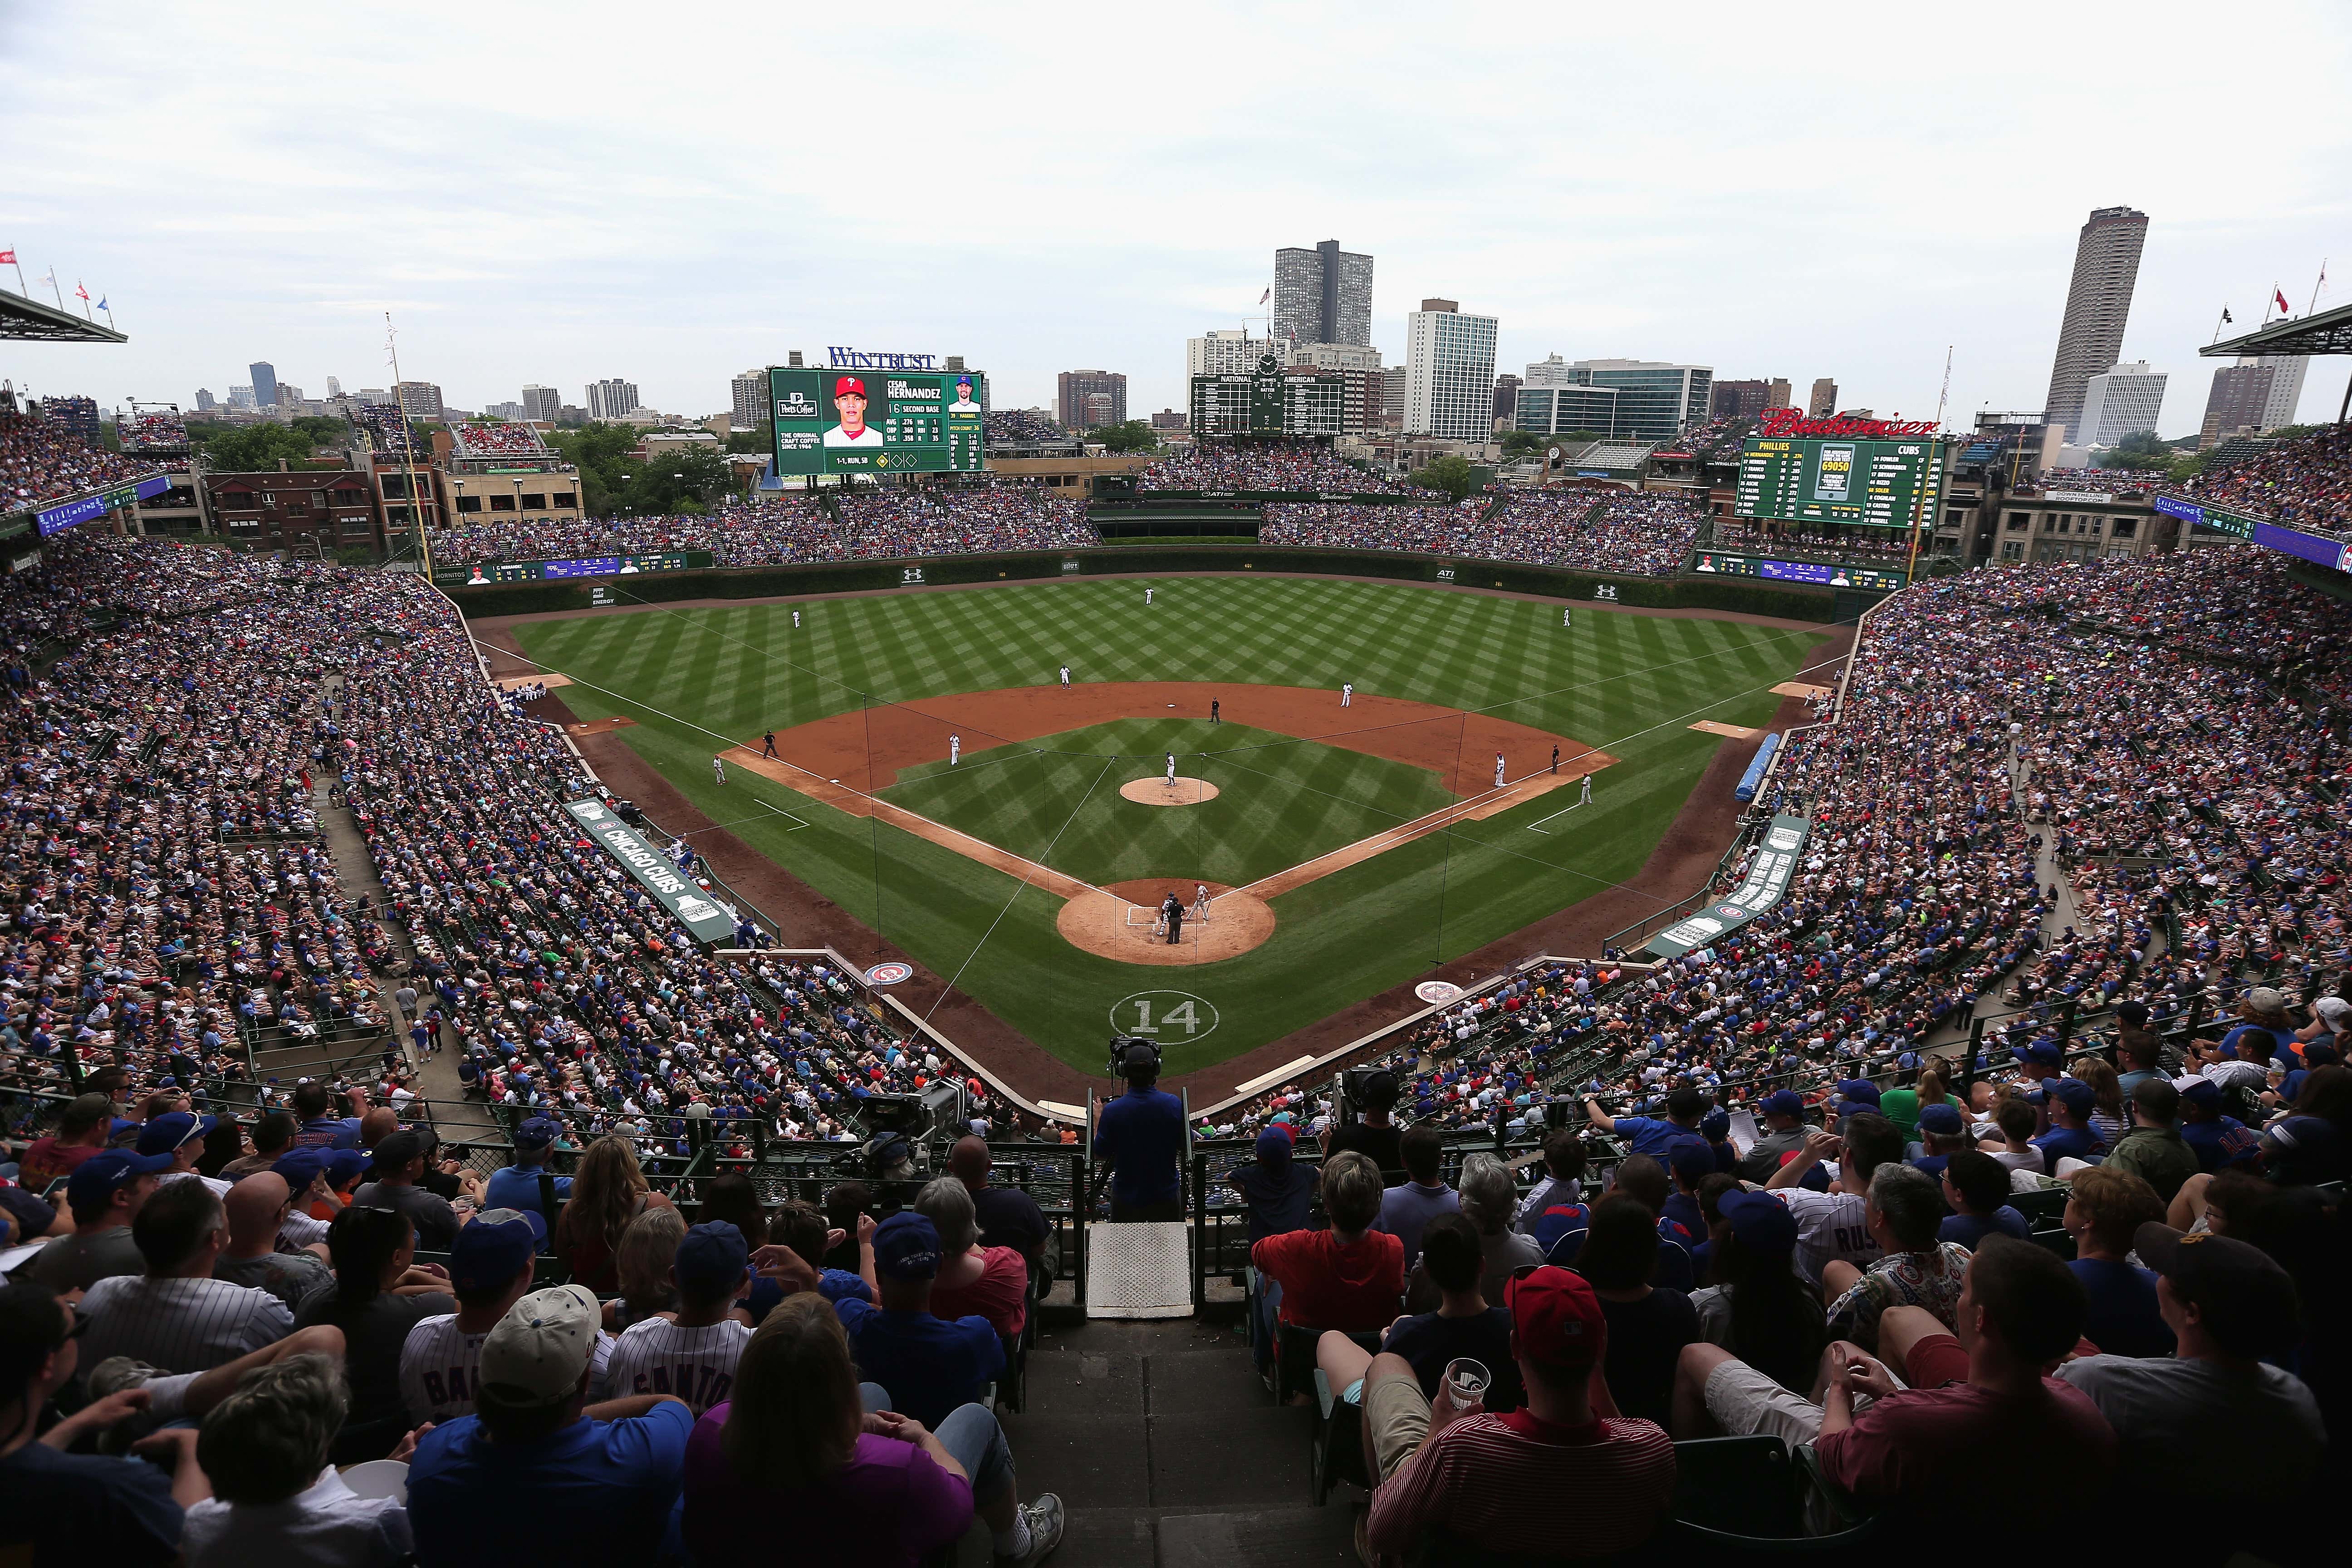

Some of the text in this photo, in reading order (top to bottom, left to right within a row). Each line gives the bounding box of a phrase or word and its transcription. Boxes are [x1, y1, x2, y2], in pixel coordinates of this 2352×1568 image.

[827, 346, 935, 369] WINTRUST
[887, 388, 941, 398] HERNANDEZ
[781, 404, 814, 415] Peet's Coffee
[889, 403, 900, 413] 16
[1759, 407, 1941, 436] Budweiser
[1759, 442, 1790, 451] PHILLIES
[1897, 446, 1920, 455] CUBS
[1822, 461, 1849, 471] 69050
[604, 829, 686, 894] CHICAGO CUBS
[1773, 853, 1793, 867] FIELD
[1727, 849, 1776, 906] WELCOME TO THE FRIENDLY
[1768, 864, 1789, 885] WRIGLEY
[1765, 882, 1780, 892] OF
[1745, 888, 1779, 912] CONFINES
[1674, 926, 1706, 940] CHICAGO
[1131, 1000, 1200, 1034] 14
[295, 1132, 338, 1146] HERIOT
[634, 1364, 733, 1407] SANTO
